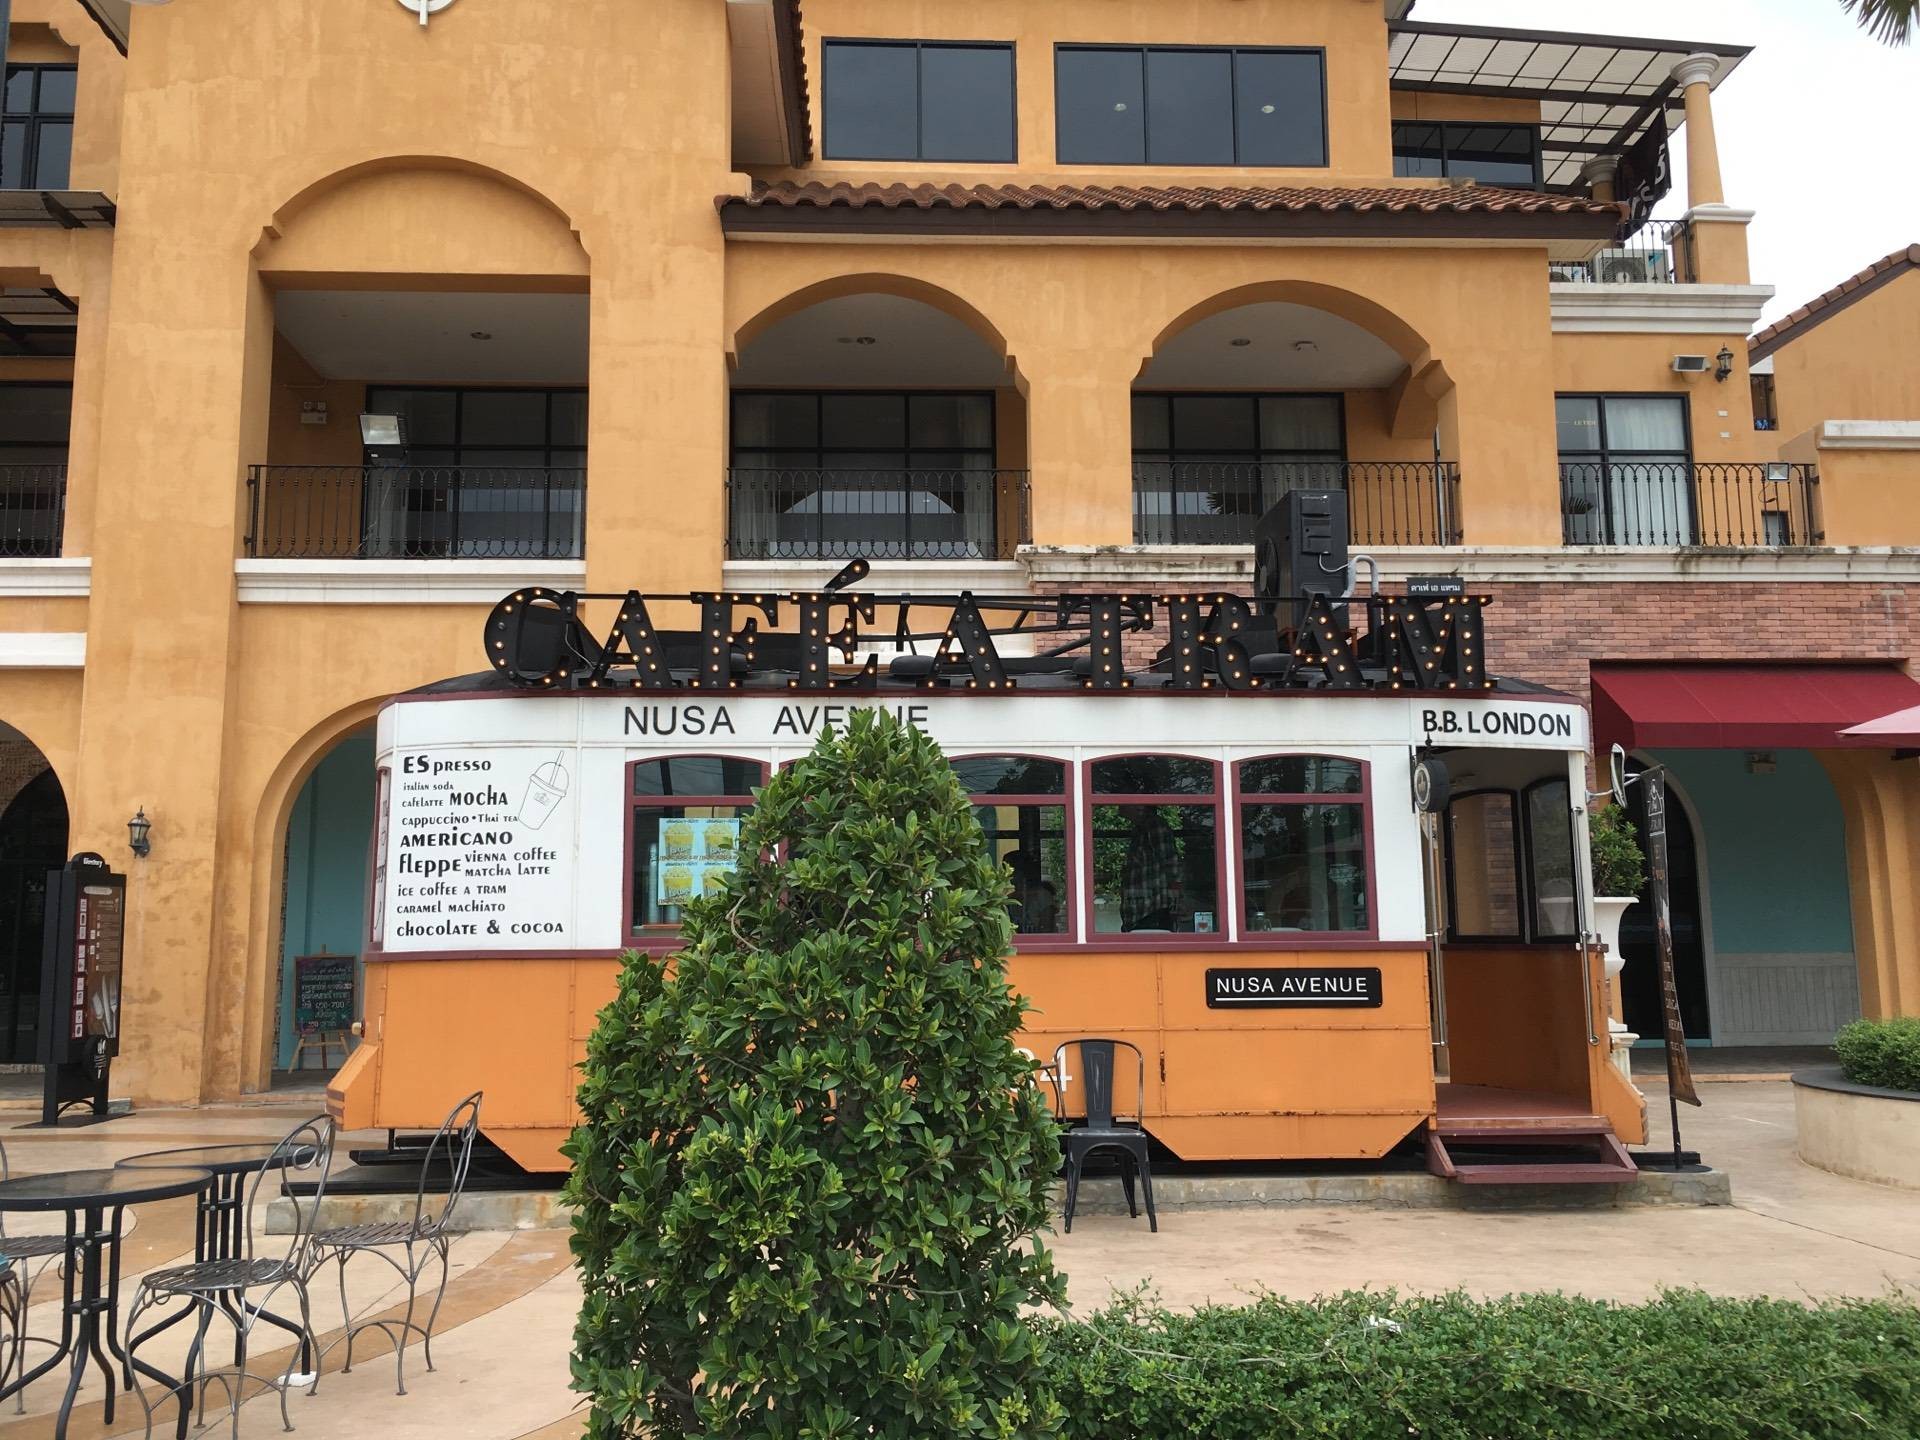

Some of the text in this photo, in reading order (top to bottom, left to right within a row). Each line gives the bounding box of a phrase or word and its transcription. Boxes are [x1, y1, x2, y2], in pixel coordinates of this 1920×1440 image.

[484, 559, 1497, 690] CAFÉ A TRAM
[623, 705, 929, 735] NUSA AVEUE
[1422, 709, 1572, 737] B.B. LONDON
[476, 884, 507, 895] TRAM
[486, 919, 501, 935] &
[1216, 976, 1368, 993] NUSA AVENUE
